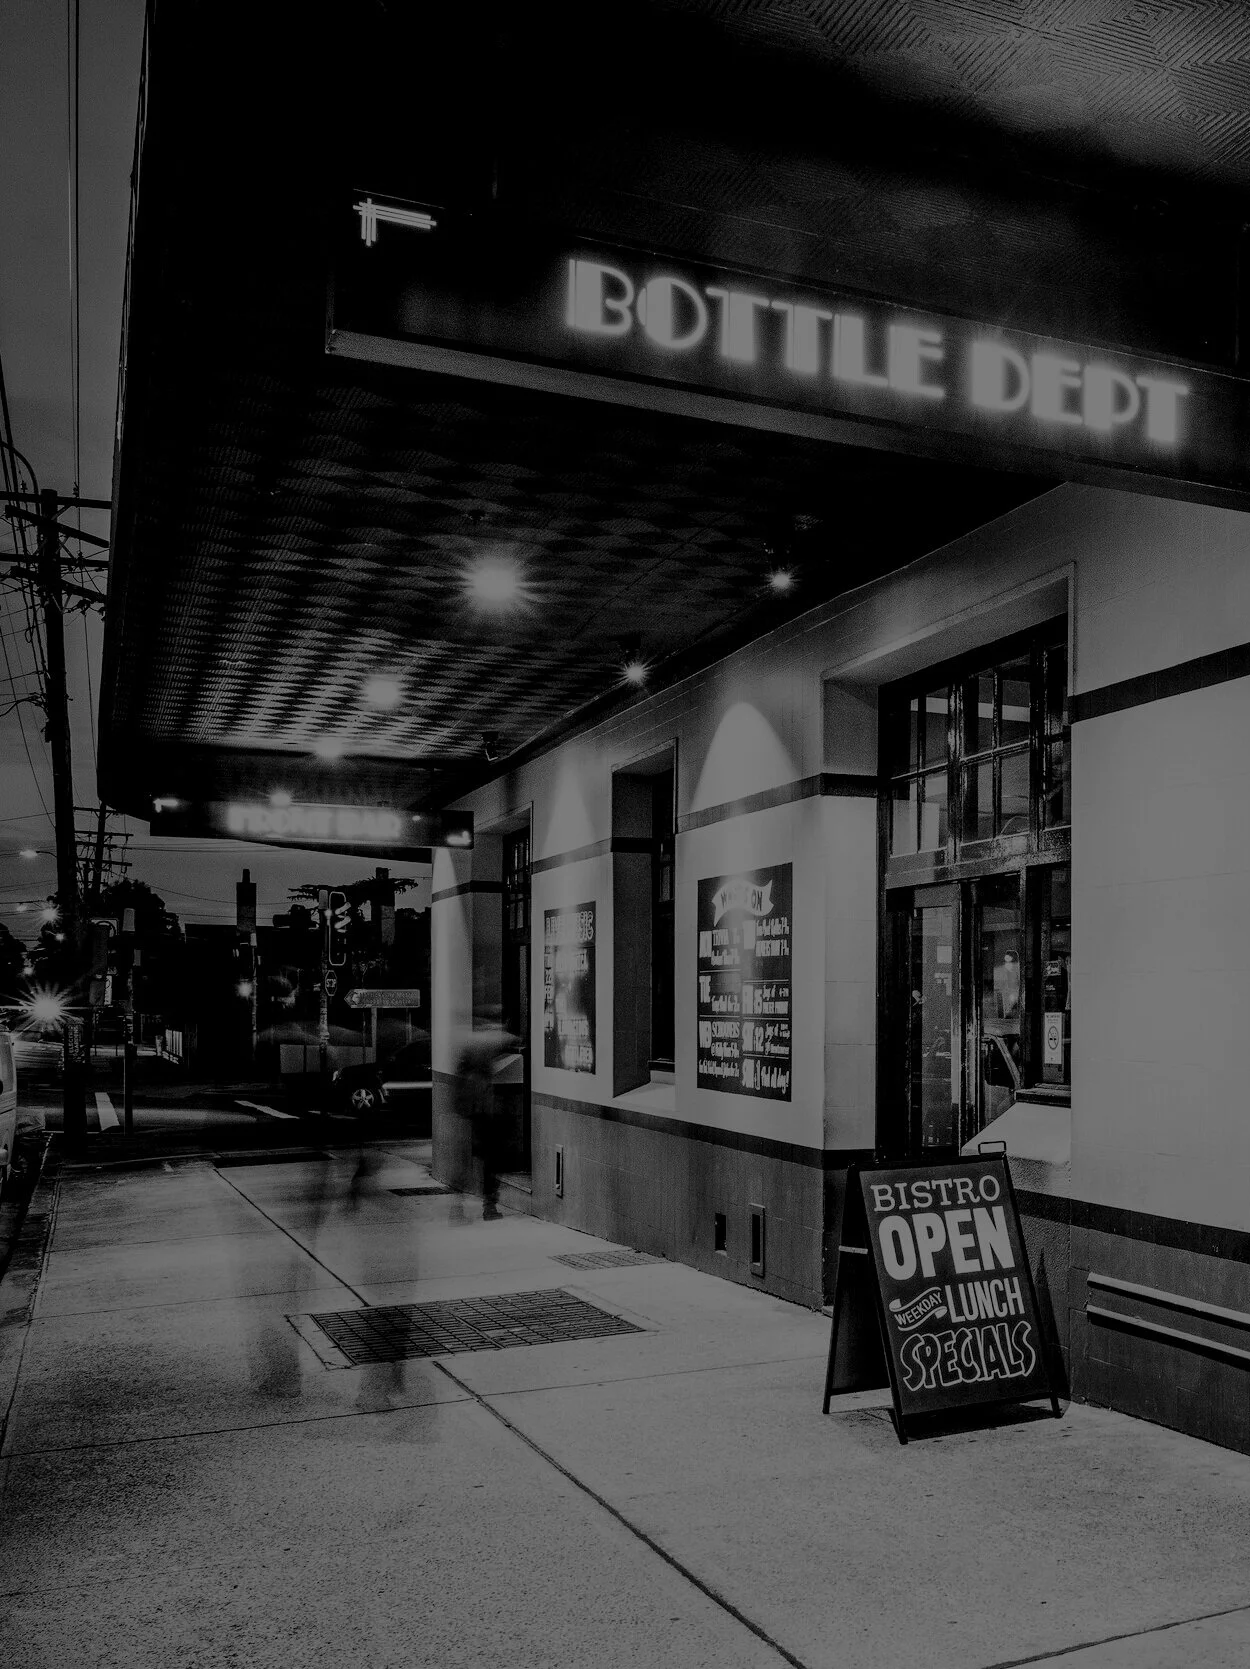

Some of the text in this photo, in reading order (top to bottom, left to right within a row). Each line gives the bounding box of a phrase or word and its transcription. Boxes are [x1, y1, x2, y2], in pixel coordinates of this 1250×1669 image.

[567, 258, 1189, 444] BOTTLE DEPT
[870, 1174, 1001, 1212] BISTRO
[878, 1205, 1016, 1281] OPEN
[894, 1276, 1026, 1326] WEEKDAY LUNCH
[900, 1320, 1036, 1392] SPECIALS
